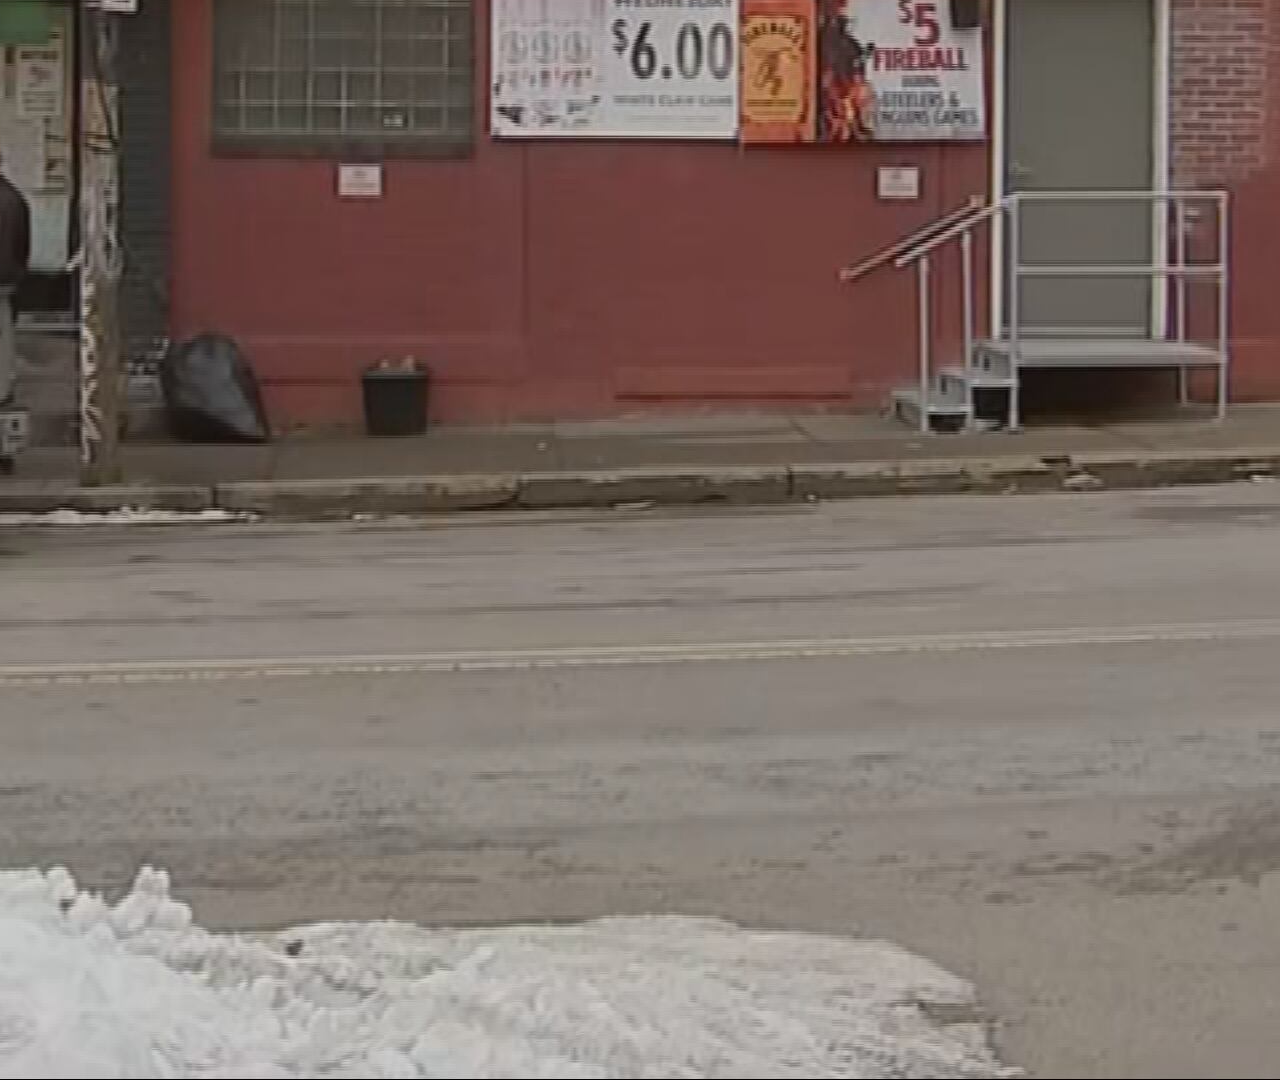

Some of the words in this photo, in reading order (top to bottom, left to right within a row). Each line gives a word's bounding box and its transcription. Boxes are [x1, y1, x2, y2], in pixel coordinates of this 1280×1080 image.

[610, 18, 734, 80] $6.00
[873, 46, 969, 71] FIREBALL
[933, 107, 979, 125] GAMES
